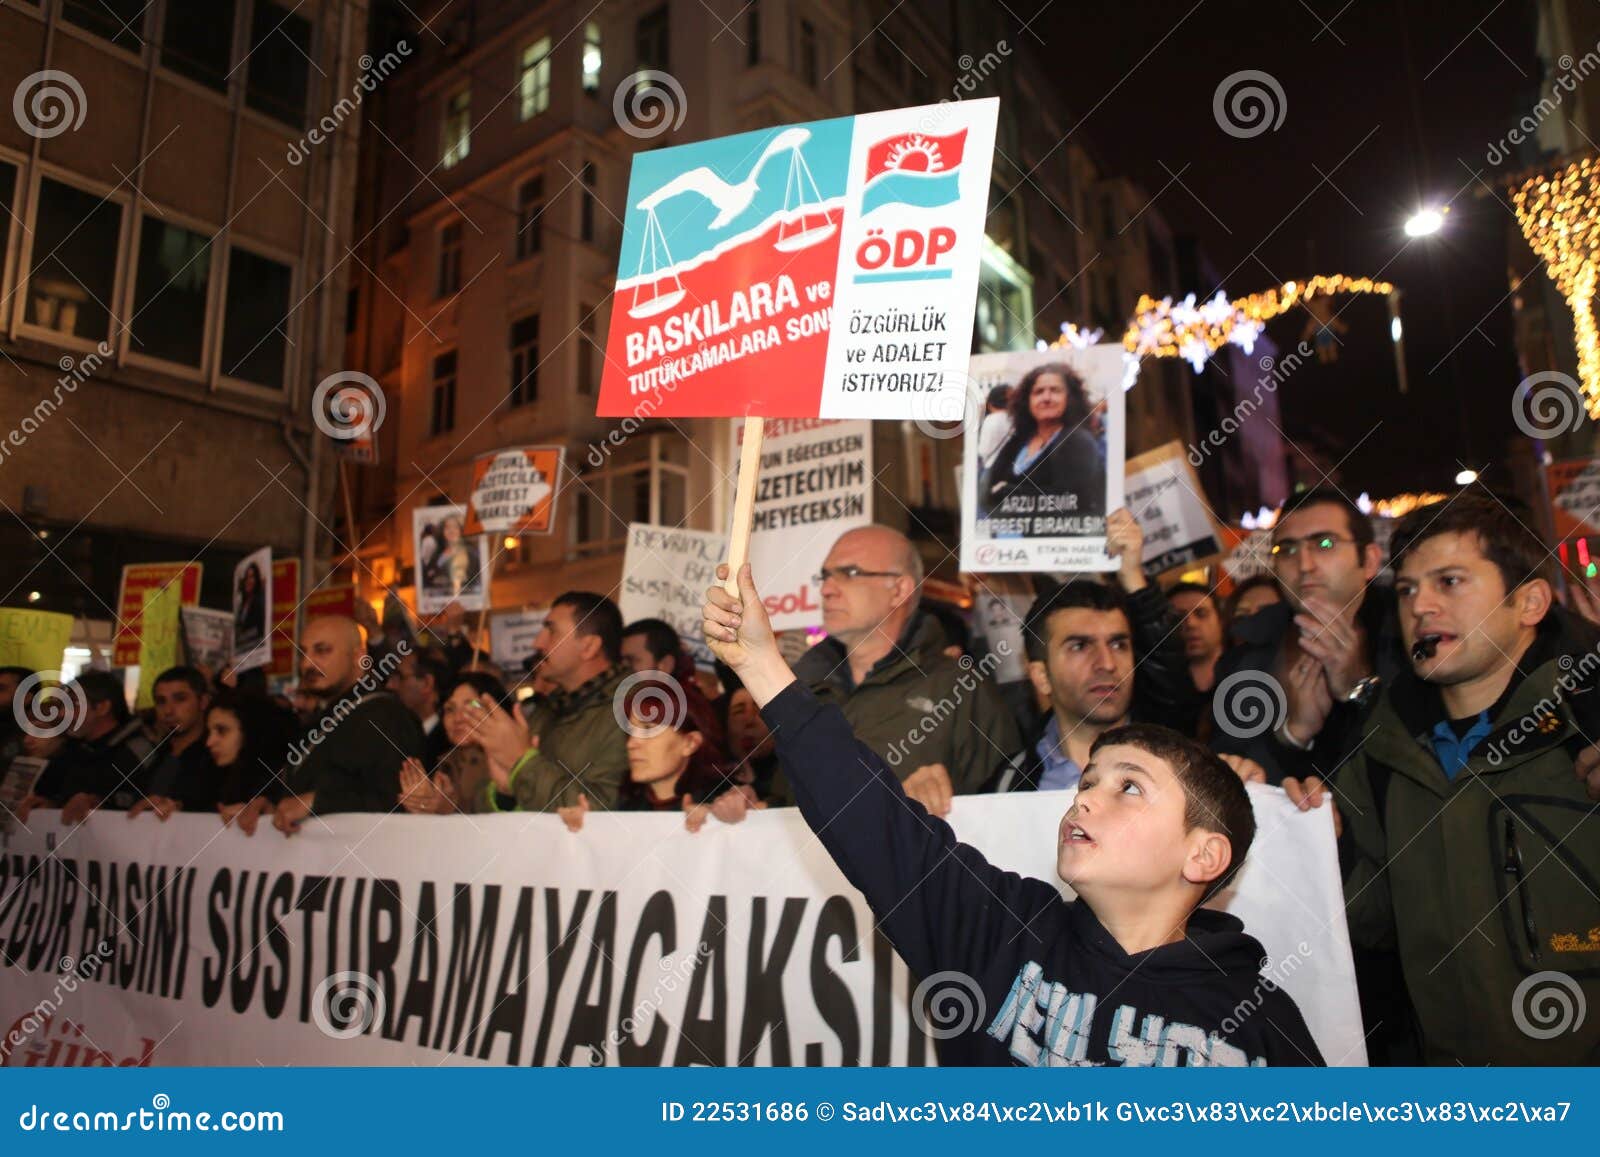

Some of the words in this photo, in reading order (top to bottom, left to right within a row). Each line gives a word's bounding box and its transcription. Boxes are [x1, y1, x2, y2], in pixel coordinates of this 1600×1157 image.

[855, 226, 957, 270] ÖDP
[626, 275, 800, 367] BASKILARA
[806, 281, 831, 302] ve
[849, 306, 947, 334] ÖZGÜRLÜK
[628, 325, 782, 395] TUTUKLAMALARA
[846, 349, 866, 363] ve
[872, 342, 947, 363] ADALET
[1000, 496, 1036, 513] ARZU
